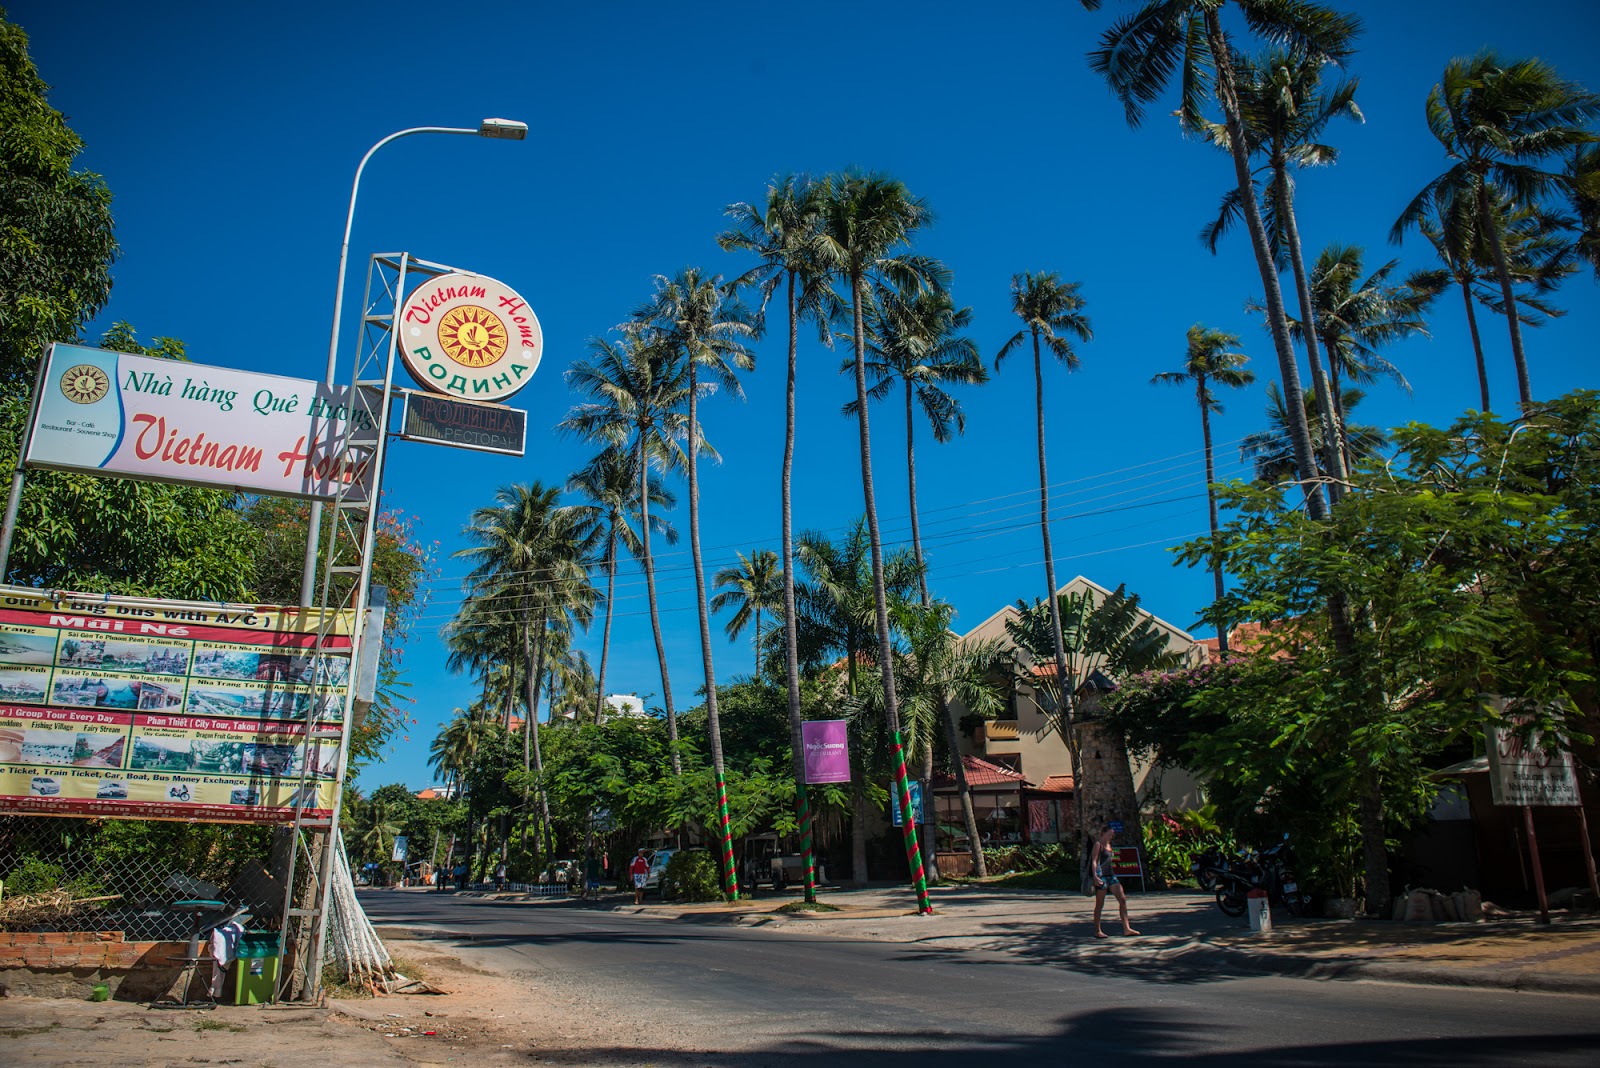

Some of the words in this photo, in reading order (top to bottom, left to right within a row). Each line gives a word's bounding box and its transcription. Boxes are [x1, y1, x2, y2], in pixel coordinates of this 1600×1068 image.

[406, 285, 486, 324] Vietnam
[498, 295, 535, 349] Home
[413, 346, 529, 395] РОДИНА
[123, 370, 173, 397] Nhà
[180, 378, 239, 412] hàng
[253, 389, 299, 416] Quê
[419, 398, 519, 434] РОДИНА
[41, 423, 73, 433] Restaurant
[76, 428, 101, 437] Souvenir
[101, 431, 117, 440] Shop
[444, 427, 518, 448] РЕСТОРАН
[132, 413, 263, 473] Vietnam
[277, 436, 369, 487] Home
[115, 604, 156, 618] bus
[163, 609, 208, 622] with
[15, 708, 43, 720] Group
[44, 710, 67, 721] Tour
[69, 712, 95, 723] Every
[97, 714, 114, 725] Day
[147, 715, 167, 726] Phan
[195, 719, 210, 731] City
[31, 721, 53, 732] Fishing
[54, 722, 74, 733] Village
[83, 724, 98, 735] Fairy
[100, 725, 121, 735] Stream
[196, 731, 213, 741] Dragon
[214, 732, 226, 742] Fruit
[227, 733, 243, 743] Garden
[8, 766, 40, 777] Ticket,
[44, 768, 68, 778] Train
[71, 770, 102, 781] Ticket,
[104, 771, 123, 783] Car,
[126, 773, 150, 784] Boat,
[152, 774, 170, 784] Bus
[172, 775, 201, 786] Money
[203, 777, 247, 788] Exchange,
[249, 779, 272, 788] Hotel
